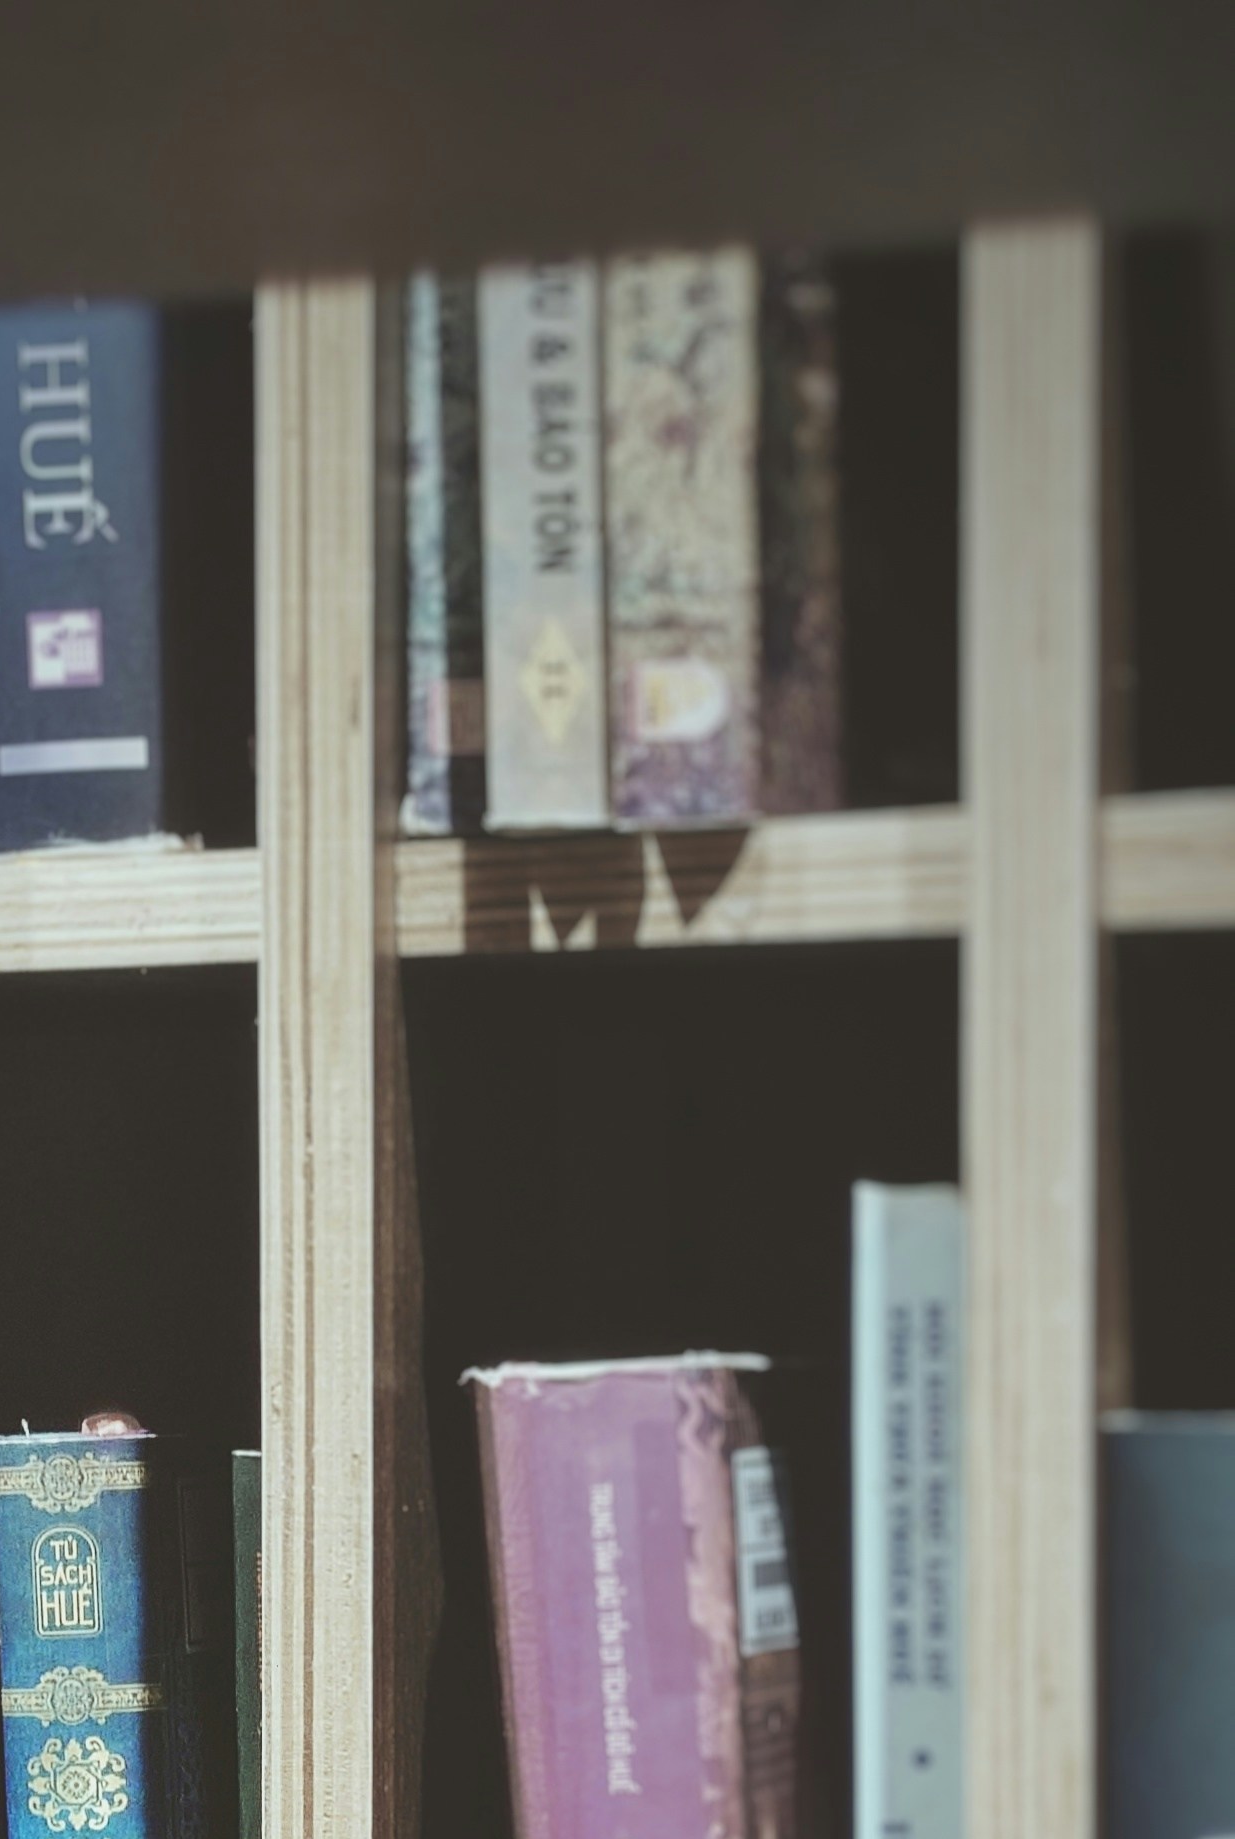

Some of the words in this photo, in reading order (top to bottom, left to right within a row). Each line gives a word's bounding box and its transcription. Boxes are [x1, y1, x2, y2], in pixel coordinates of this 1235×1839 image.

[532, 334, 578, 365] &
[16, 338, 119, 549] HUẾ
[41, 1563, 91, 1585] SÁCH
[42, 1583, 93, 1627] HUẾ
